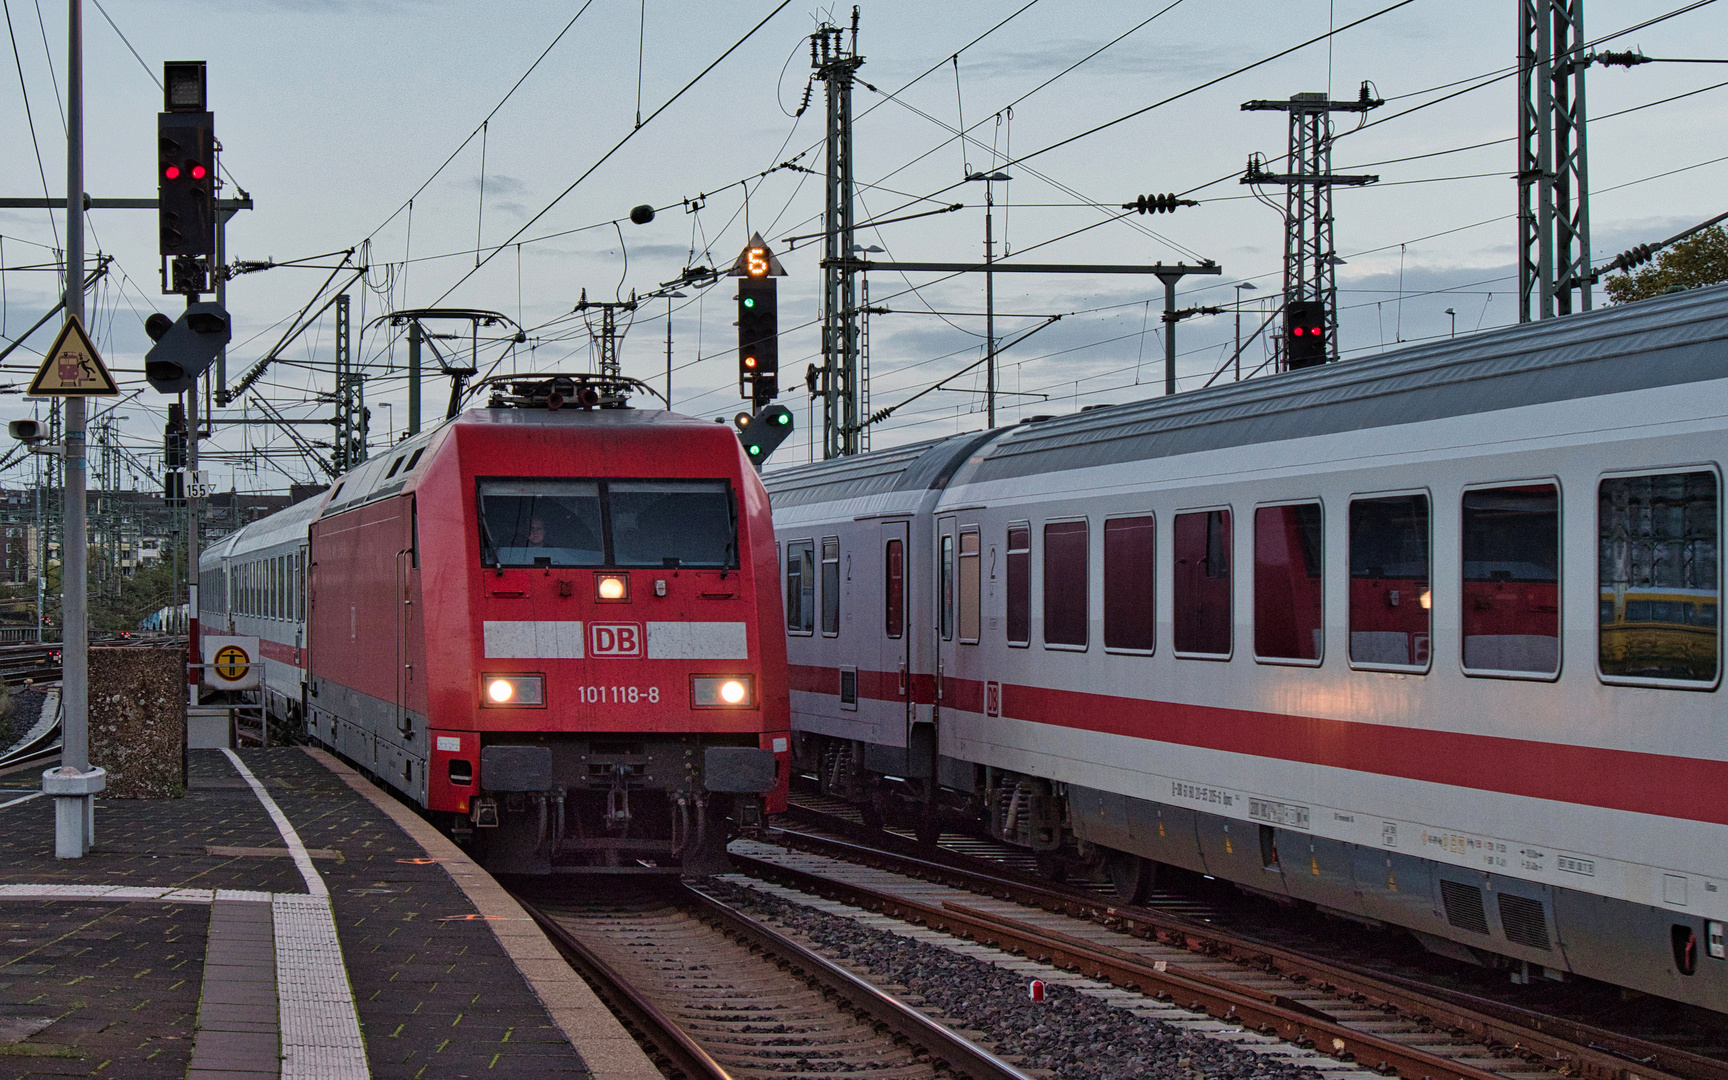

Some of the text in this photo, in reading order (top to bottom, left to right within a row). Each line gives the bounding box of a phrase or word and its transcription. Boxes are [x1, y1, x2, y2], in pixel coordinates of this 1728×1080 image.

[186, 484, 206, 497] 155
[192, 471, 199, 484] N
[846, 553, 852, 581] 2
[990, 547, 996, 580] 2
[595, 627, 637, 653] DB
[578, 686, 660, 704] 101 118-8
[987, 686, 998, 712] DB
